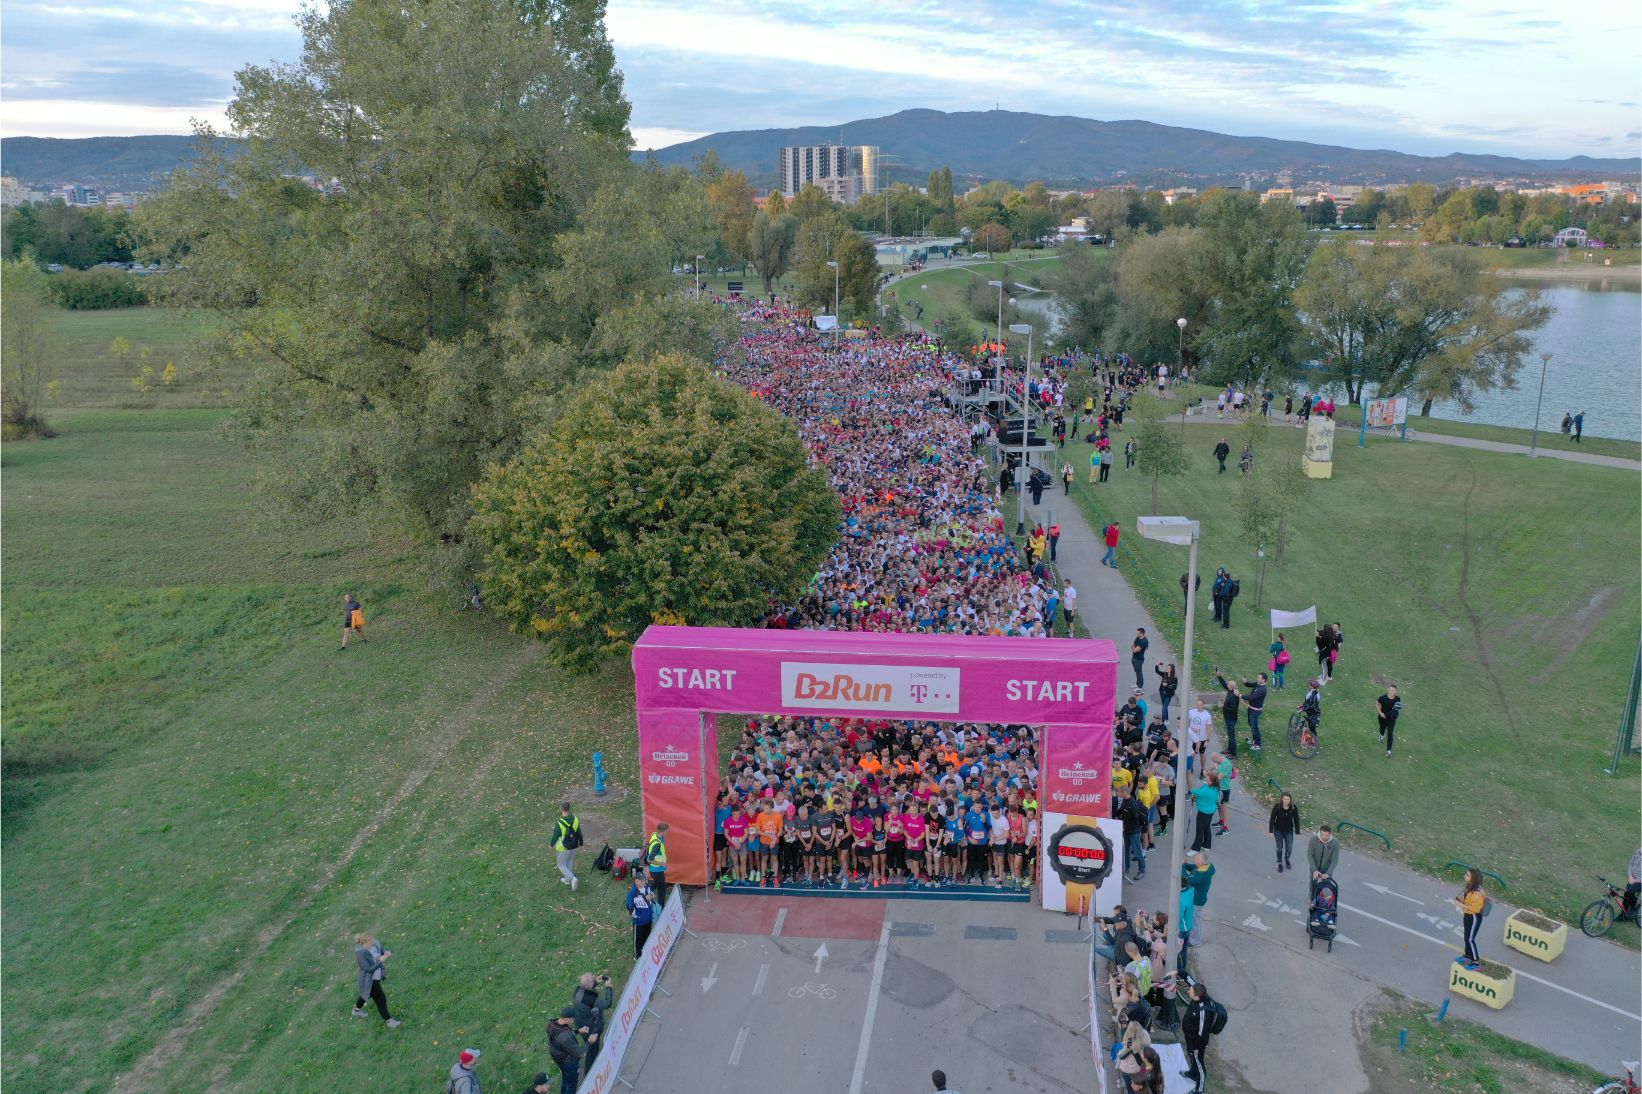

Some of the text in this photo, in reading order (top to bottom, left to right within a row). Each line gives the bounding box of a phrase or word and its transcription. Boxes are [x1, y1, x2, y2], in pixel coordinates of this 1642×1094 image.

[658, 667, 737, 690] START
[794, 673, 893, 702] B2Run
[910, 672, 947, 681] powered by
[1006, 679, 1090, 702] START
[661, 775, 694, 785] GRAWE
[1060, 769, 1096, 778] Heineken
[1065, 793, 1101, 803] GRAWE
[1506, 925, 1549, 951] jarun
[1452, 970, 1497, 999] jarun
